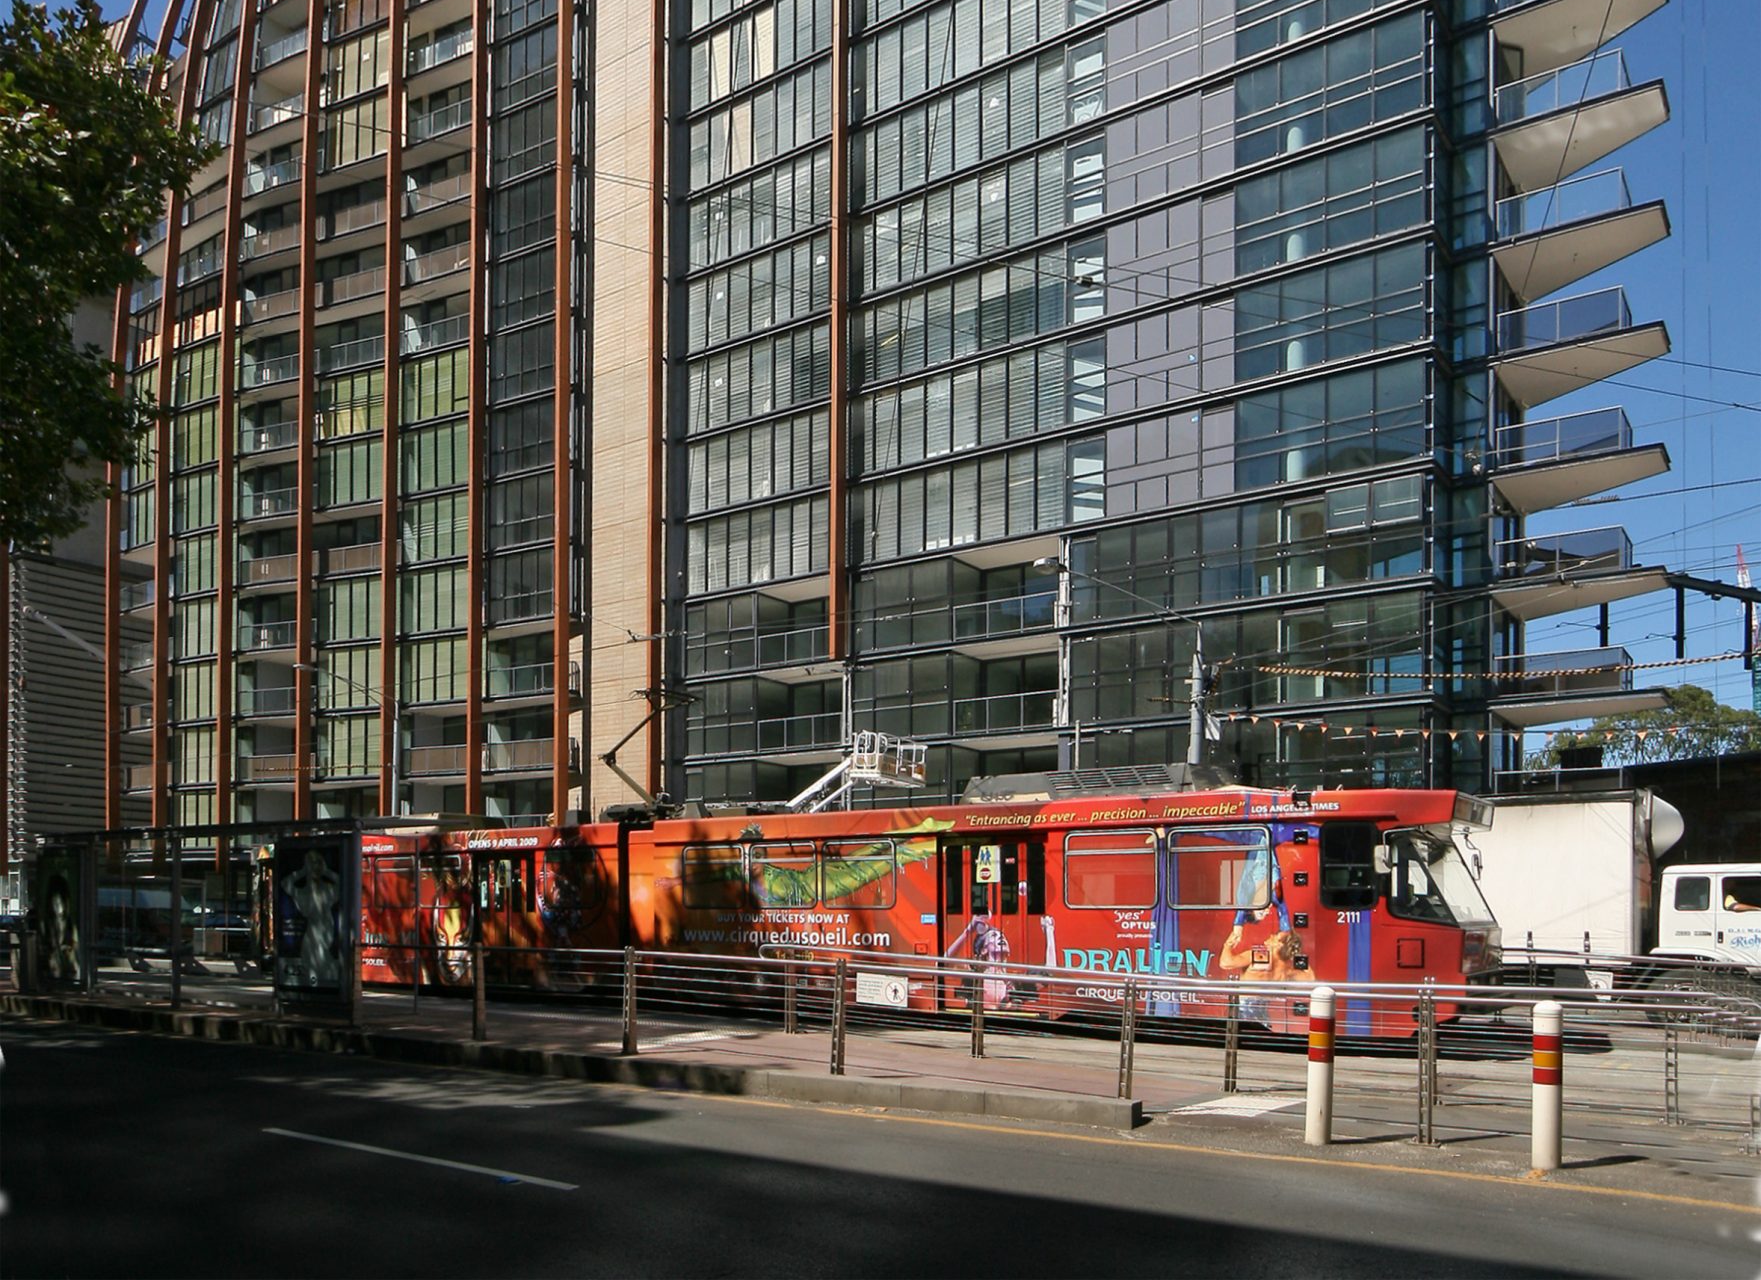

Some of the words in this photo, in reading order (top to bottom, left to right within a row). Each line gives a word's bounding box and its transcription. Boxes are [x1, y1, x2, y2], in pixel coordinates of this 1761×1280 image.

[1311, 802, 1340, 811] TIMES
[966, 812, 1031, 827] "Entrancing
[1034, 815, 1047, 823] as
[1050, 812, 1076, 822] ever
[1090, 807, 1146, 823] precision
[468, 840, 491, 849] OPENS
[492, 840, 497, 848] 9
[498, 838, 518, 847] APRIL
[520, 837, 538, 846] 2009
[738, 913, 764, 923] YOUR
[766, 913, 805, 924] TICKETS
[807, 913, 834, 924] NOW
[836, 913, 850, 924] AT
[1337, 911, 1360, 923] 2111
[1121, 921, 1156, 930] OPTUS
[684, 926, 890, 949] www.cirquedusoleil.com
[1075, 987, 1126, 1002] CIRQUE
